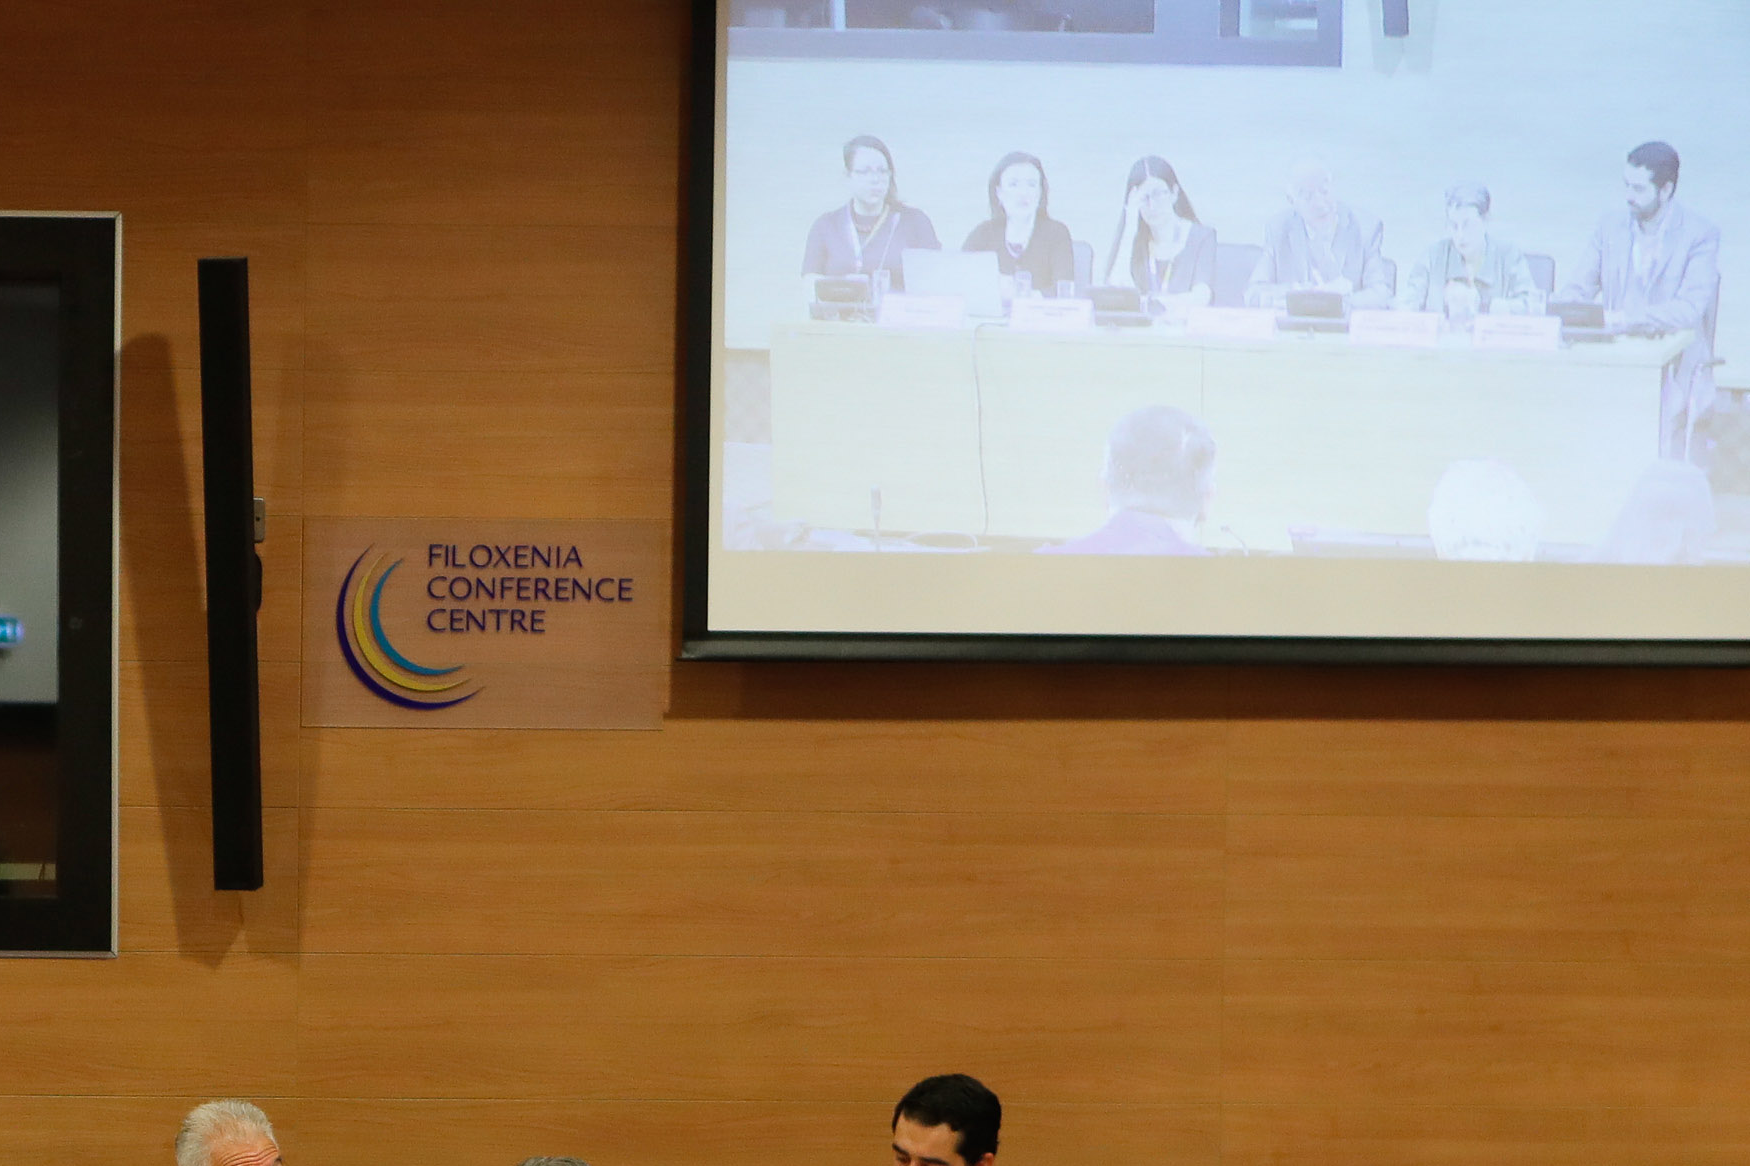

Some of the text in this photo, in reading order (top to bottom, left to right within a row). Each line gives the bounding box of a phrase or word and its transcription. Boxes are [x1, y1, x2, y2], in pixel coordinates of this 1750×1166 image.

[427, 544, 583, 568] FILOXENIA
[427, 576, 634, 602] CONFERENCE
[427, 608, 547, 632] CENTRE
